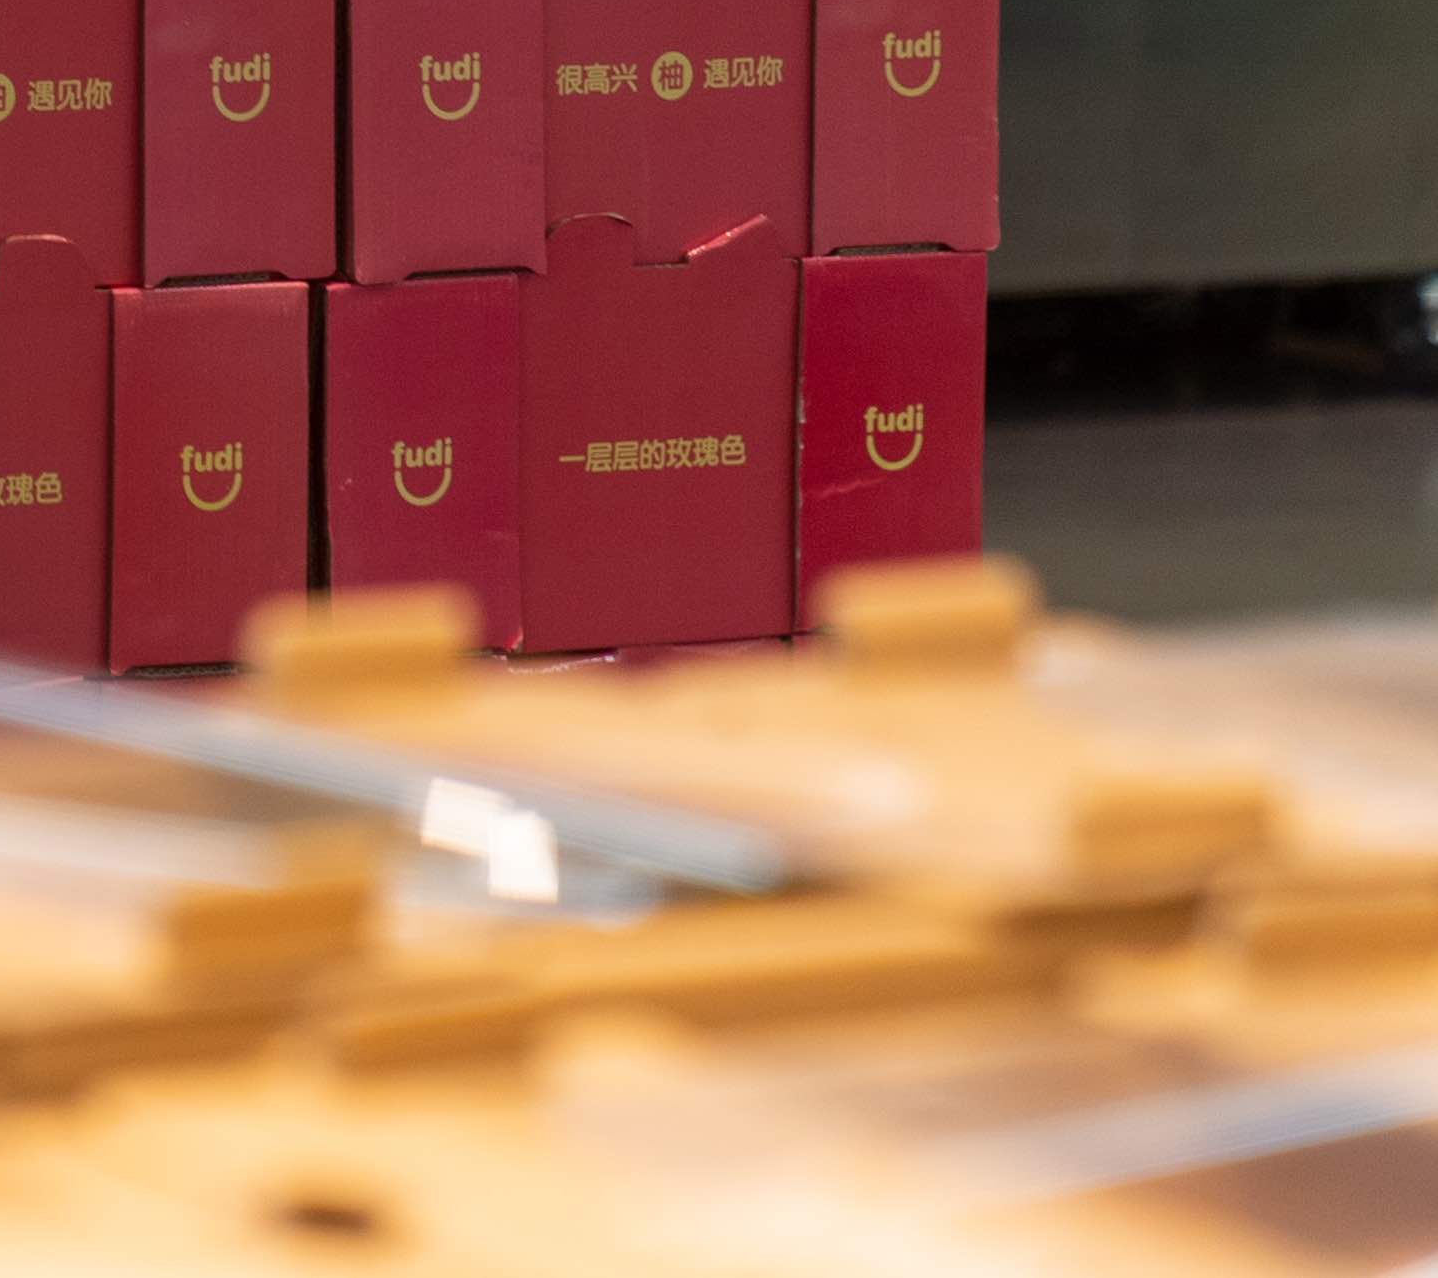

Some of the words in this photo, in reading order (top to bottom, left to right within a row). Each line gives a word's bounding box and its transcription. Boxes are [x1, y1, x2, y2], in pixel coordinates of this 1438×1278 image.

[882, 30, 942, 58] fudi
[210, 53, 271, 83] fudi
[419, 53, 482, 83] fudi
[556, 62, 638, 96] 很高兴
[703, 56, 784, 90] 遇见你
[27, 78, 113, 112] 遇见你
[864, 403, 924, 434] fudi
[180, 442, 243, 473] fudi
[392, 437, 453, 468] fudi
[559, 433, 747, 473] 一层层的玫瑰色
